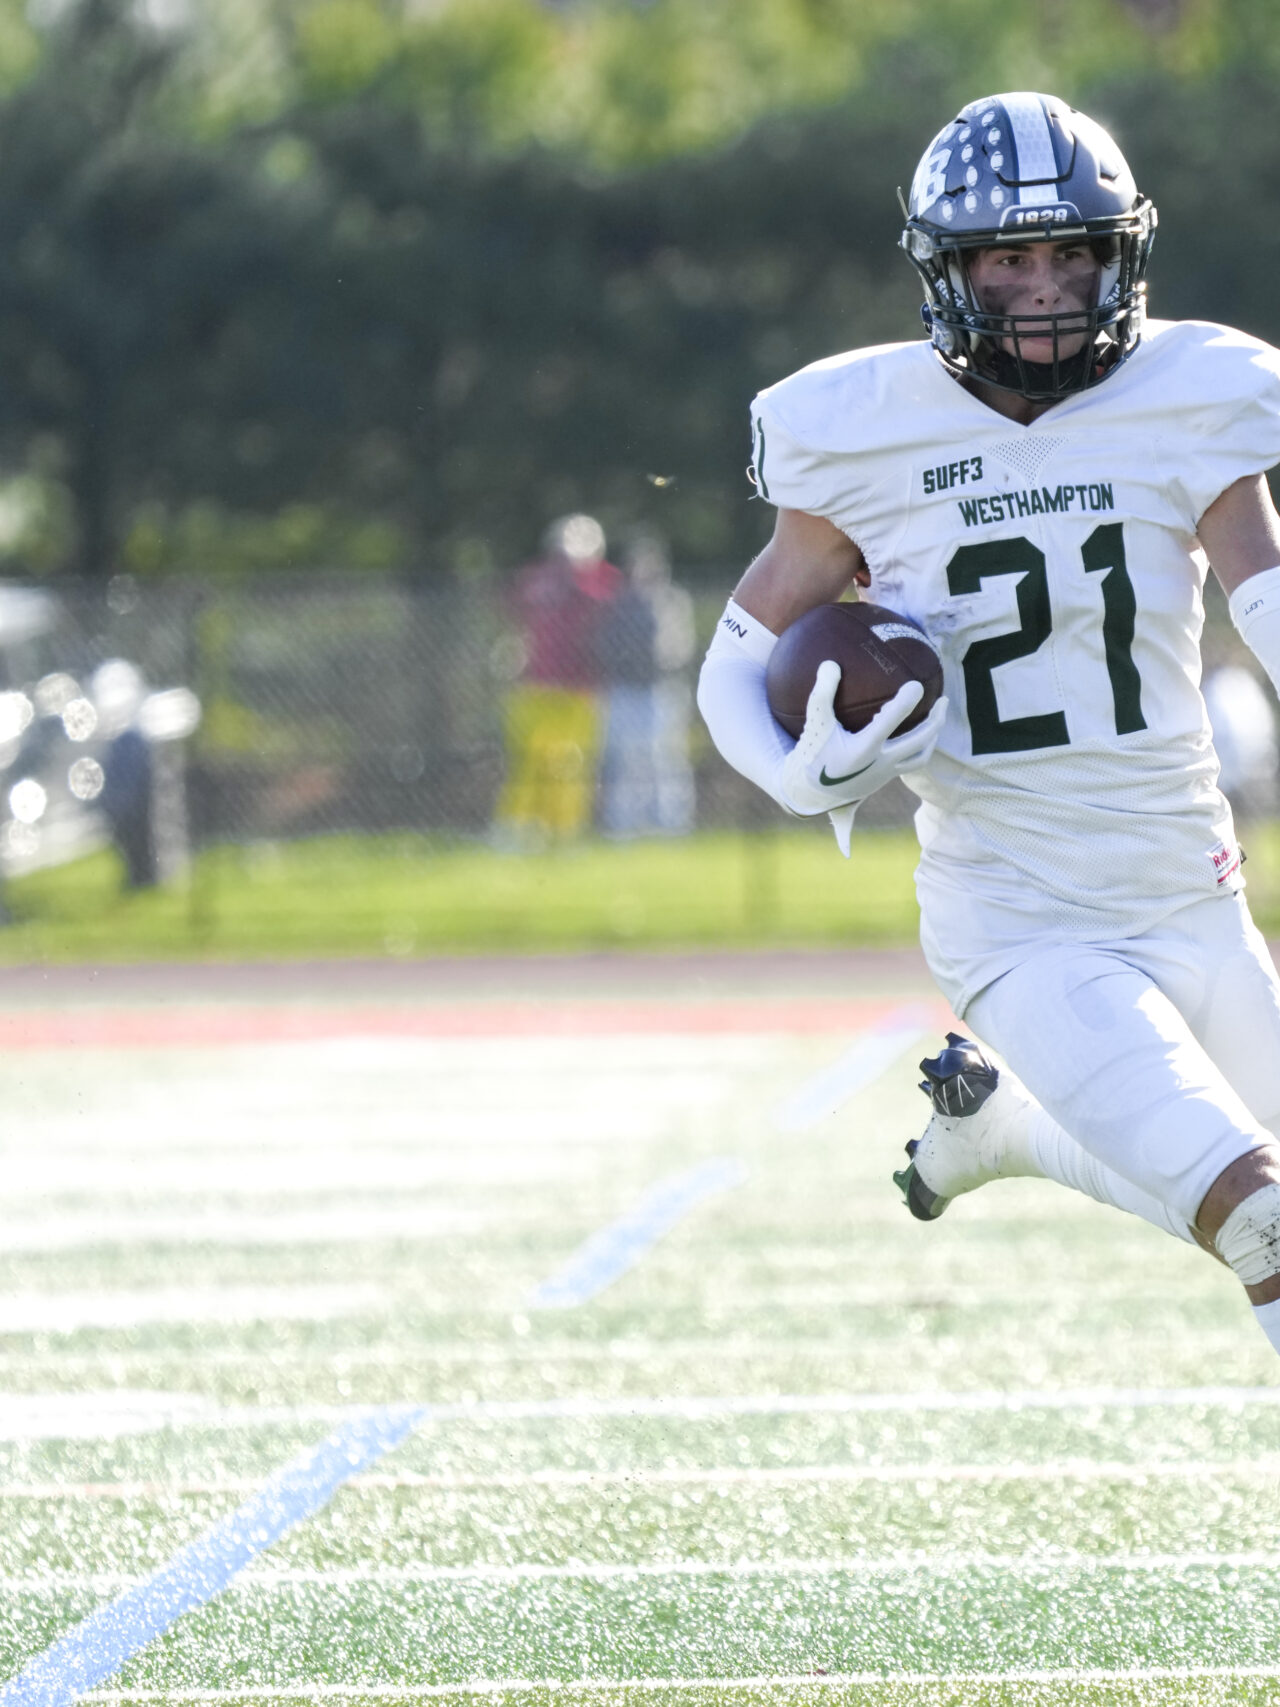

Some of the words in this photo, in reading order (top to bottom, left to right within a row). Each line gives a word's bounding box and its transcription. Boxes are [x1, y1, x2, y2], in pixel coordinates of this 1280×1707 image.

[923, 456, 983, 494] SUFF3
[958, 483, 1115, 527] WESTHAMPTON
[946, 522, 1148, 756] 21
